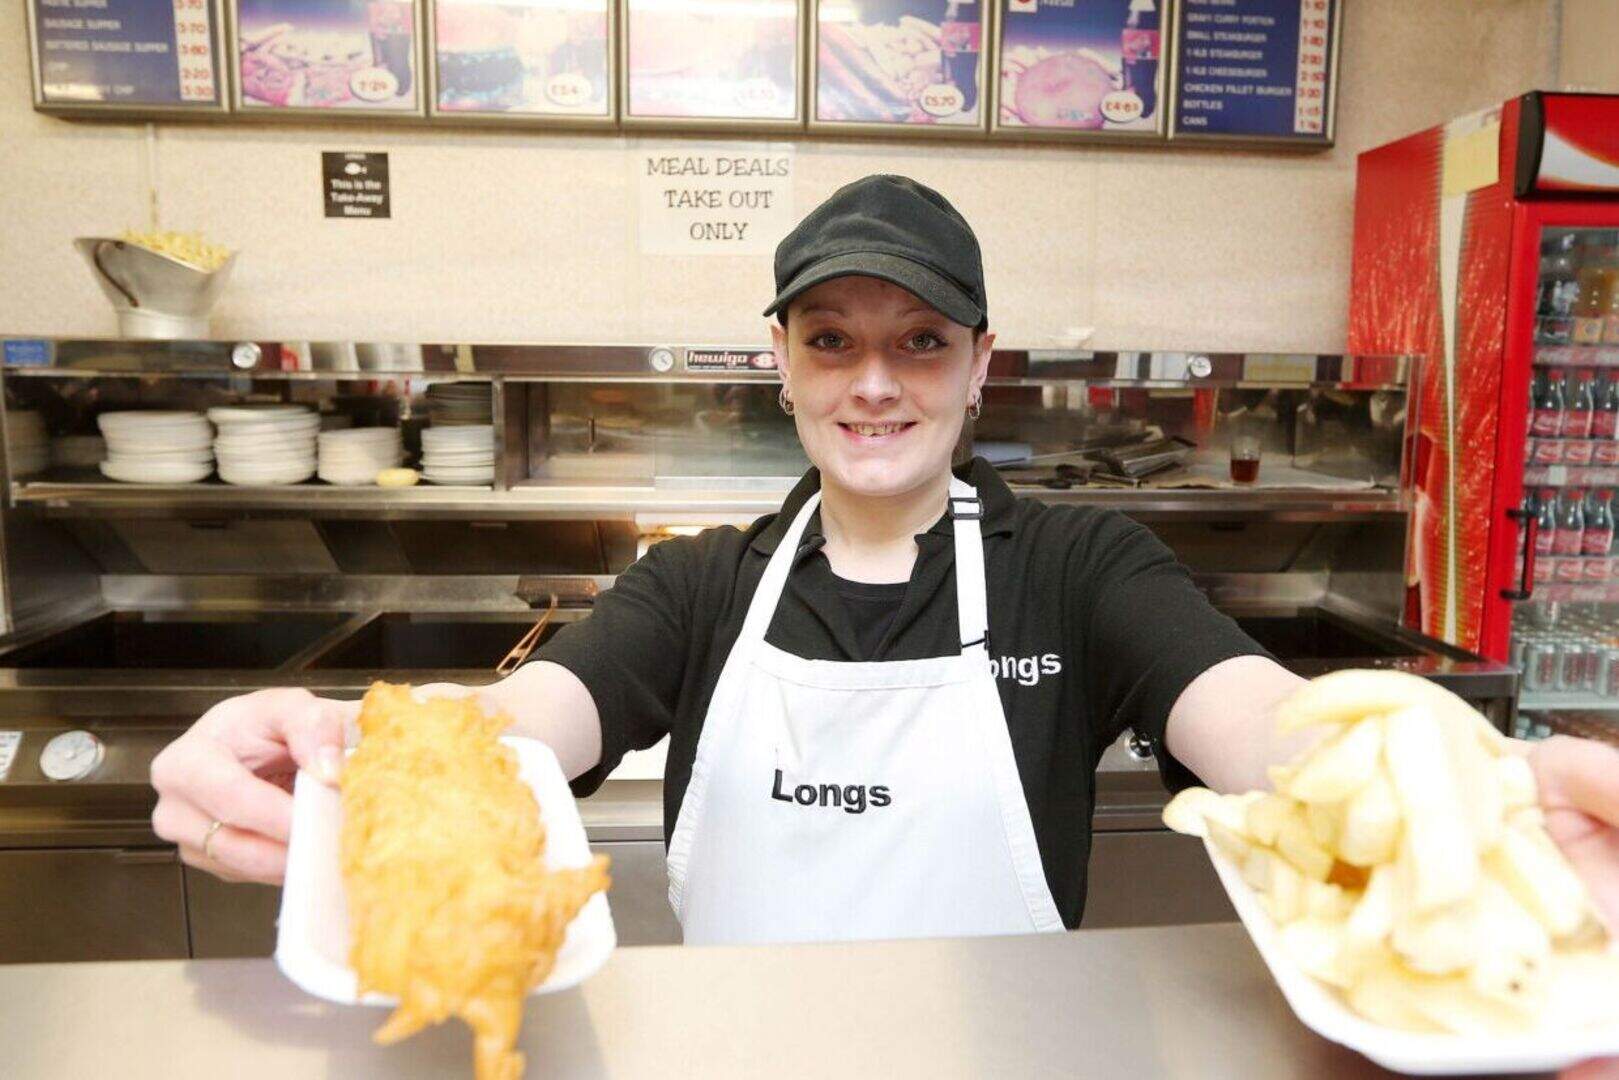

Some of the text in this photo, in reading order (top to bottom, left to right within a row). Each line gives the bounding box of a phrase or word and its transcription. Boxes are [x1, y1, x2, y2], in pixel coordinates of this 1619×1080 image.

[134, 42, 168, 53] SUPPER
[1184, 83, 1292, 97] CHICKEN FILLET BURGER
[1183, 99, 1223, 111] BOTTLES
[1182, 116, 1208, 127] CANS
[647, 157, 789, 176] MEAL DEALS
[330, 178, 382, 191] This is the
[664, 189, 772, 208] TAKE OUT
[343, 204, 372, 216] Menu
[689, 221, 748, 240] ONLY
[988, 651, 1062, 686] ongs
[771, 768, 892, 814] Longs
